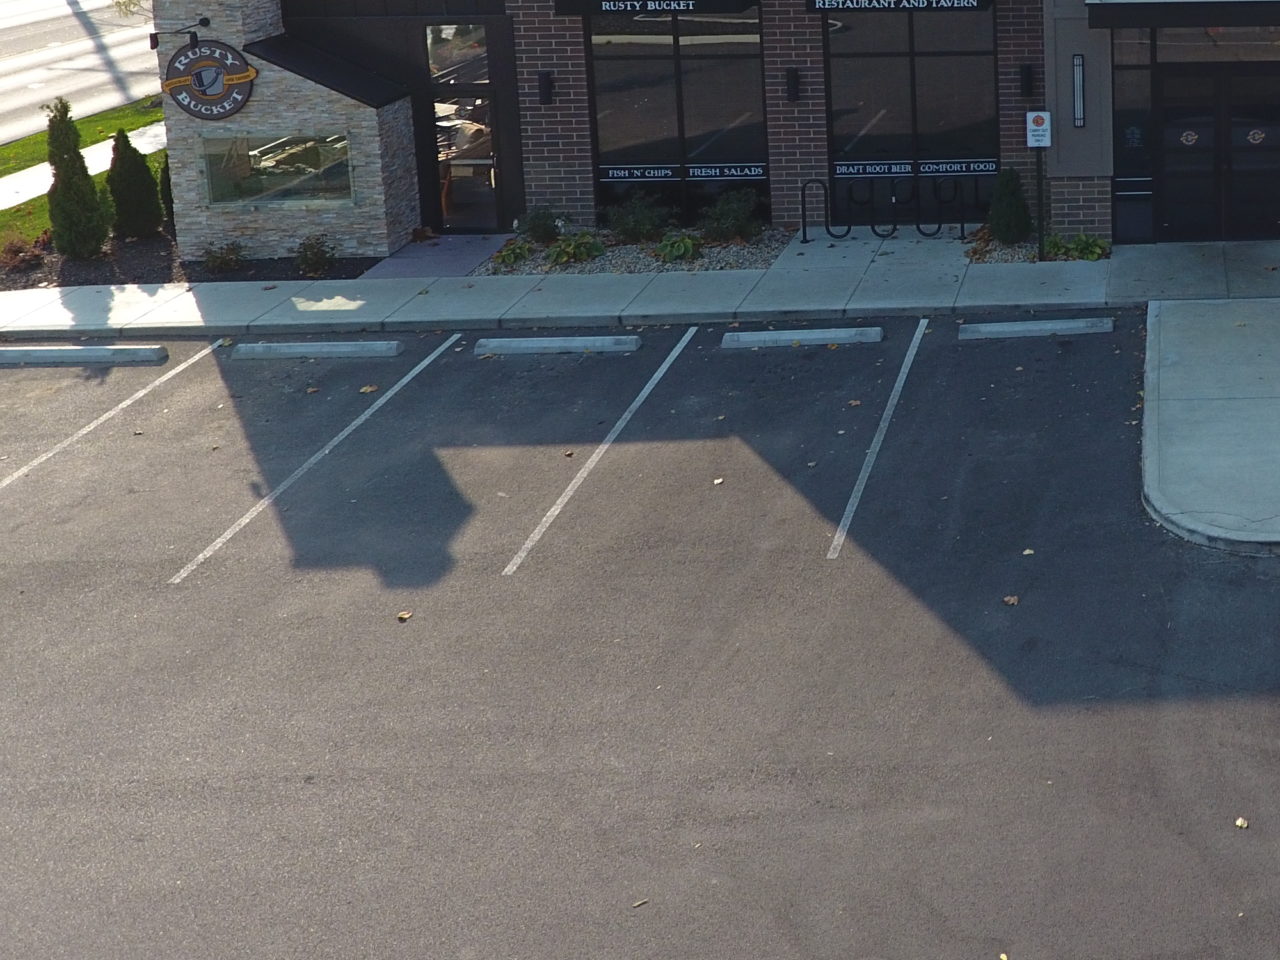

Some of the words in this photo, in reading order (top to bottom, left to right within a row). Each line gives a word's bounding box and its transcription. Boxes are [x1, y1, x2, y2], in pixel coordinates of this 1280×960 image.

[601, 0, 643, 11] RUSTY
[646, 0, 696, 10] BUCKET
[174, 46, 240, 71] RUSTY
[176, 90, 243, 114] BUCKET
[689, 168, 720, 176] FRESH
[723, 167, 763, 175] SALADS
[836, 165, 864, 174] DRAFT
[866, 165, 889, 173] ROOT
[891, 164, 912, 172] BEER
[920, 163, 967, 172] COMFORT
[970, 162, 996, 171] FOOD
[608, 169, 629, 177] FISH
[645, 169, 673, 177] CHIPS
